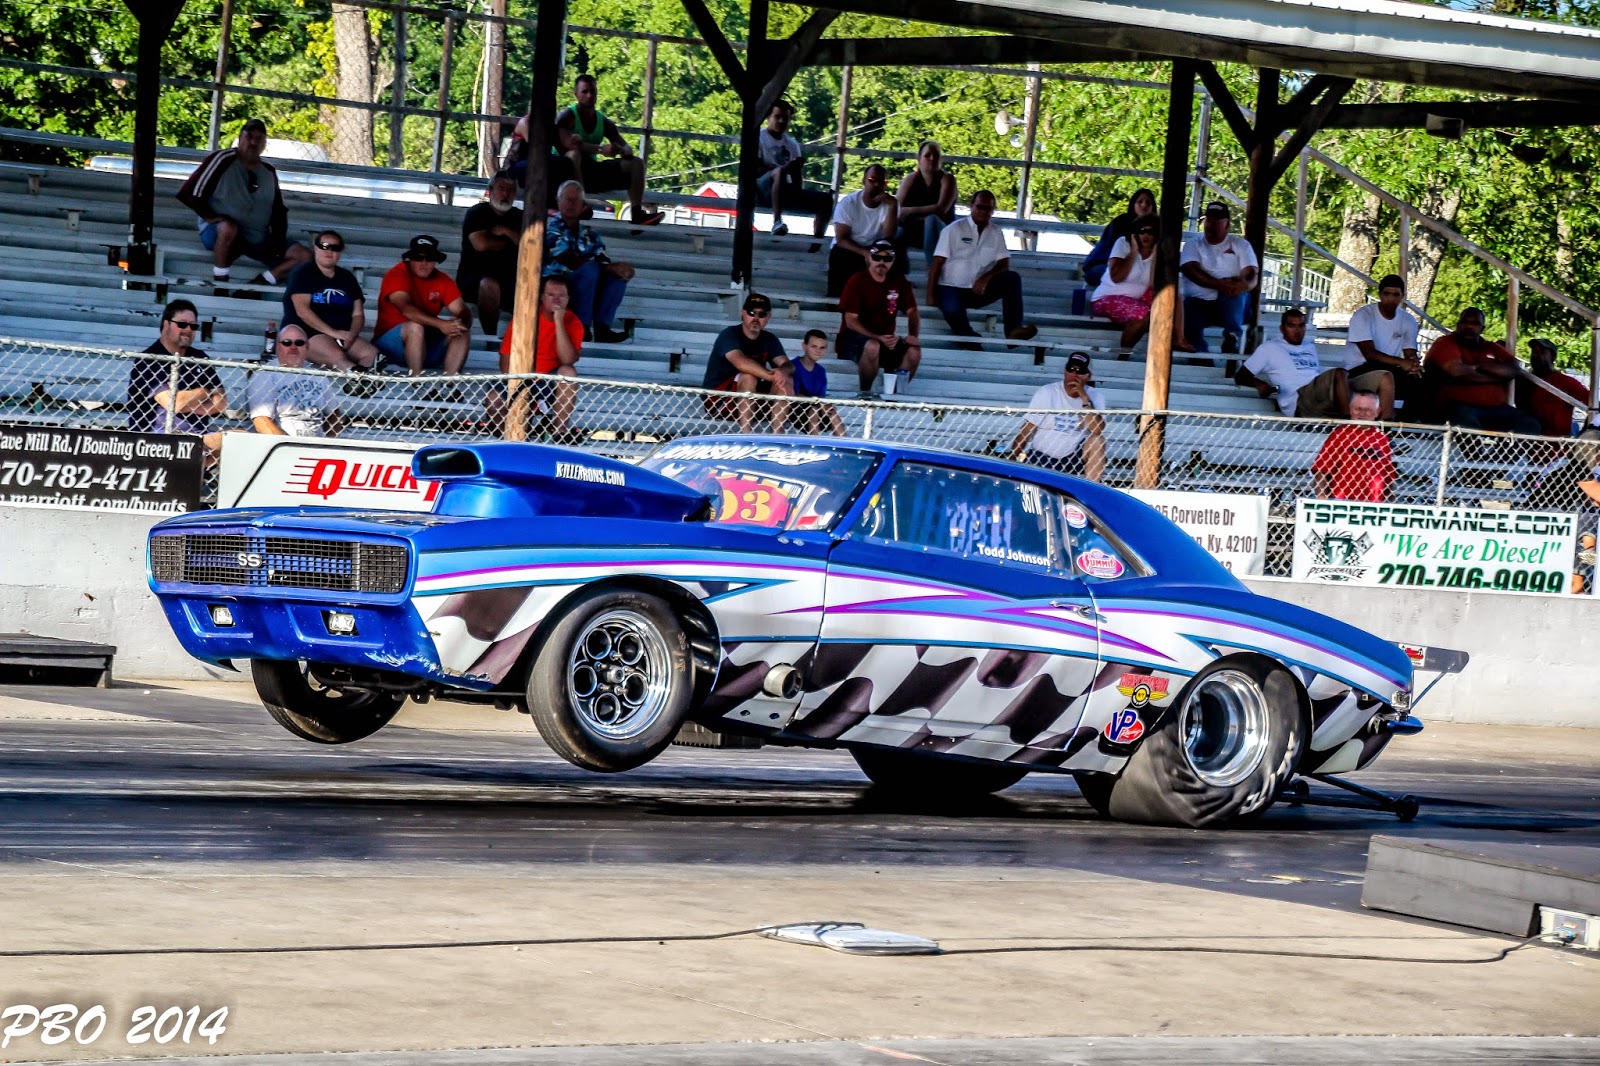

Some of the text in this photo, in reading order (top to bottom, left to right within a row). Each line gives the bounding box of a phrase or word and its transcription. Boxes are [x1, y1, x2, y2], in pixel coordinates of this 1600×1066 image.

[0, 431, 22, 449] ave
[25, 432, 49, 451] Mill
[51, 434, 73, 453] Rd.
[136, 439, 174, 460] Green,
[176, 441, 195, 460] KY
[0, 461, 167, 493] 70-782-4714
[307, 459, 418, 500] QUICK
[1171, 506, 1220, 525] Corvette
[1223, 508, 1235, 526] Dr
[1303, 502, 1571, 536] TSPERFORMANCE.COM
[977, 543, 1050, 566] Todd Johnson
[1207, 534, 1223, 553] Ky.
[1226, 535, 1258, 553] 42101
[1384, 533, 1561, 564] "We Are Diesel"
[237, 553, 262, 567] SS
[1378, 563, 1565, 594] 270-746-9999
[1109, 710, 1138, 741] VP
